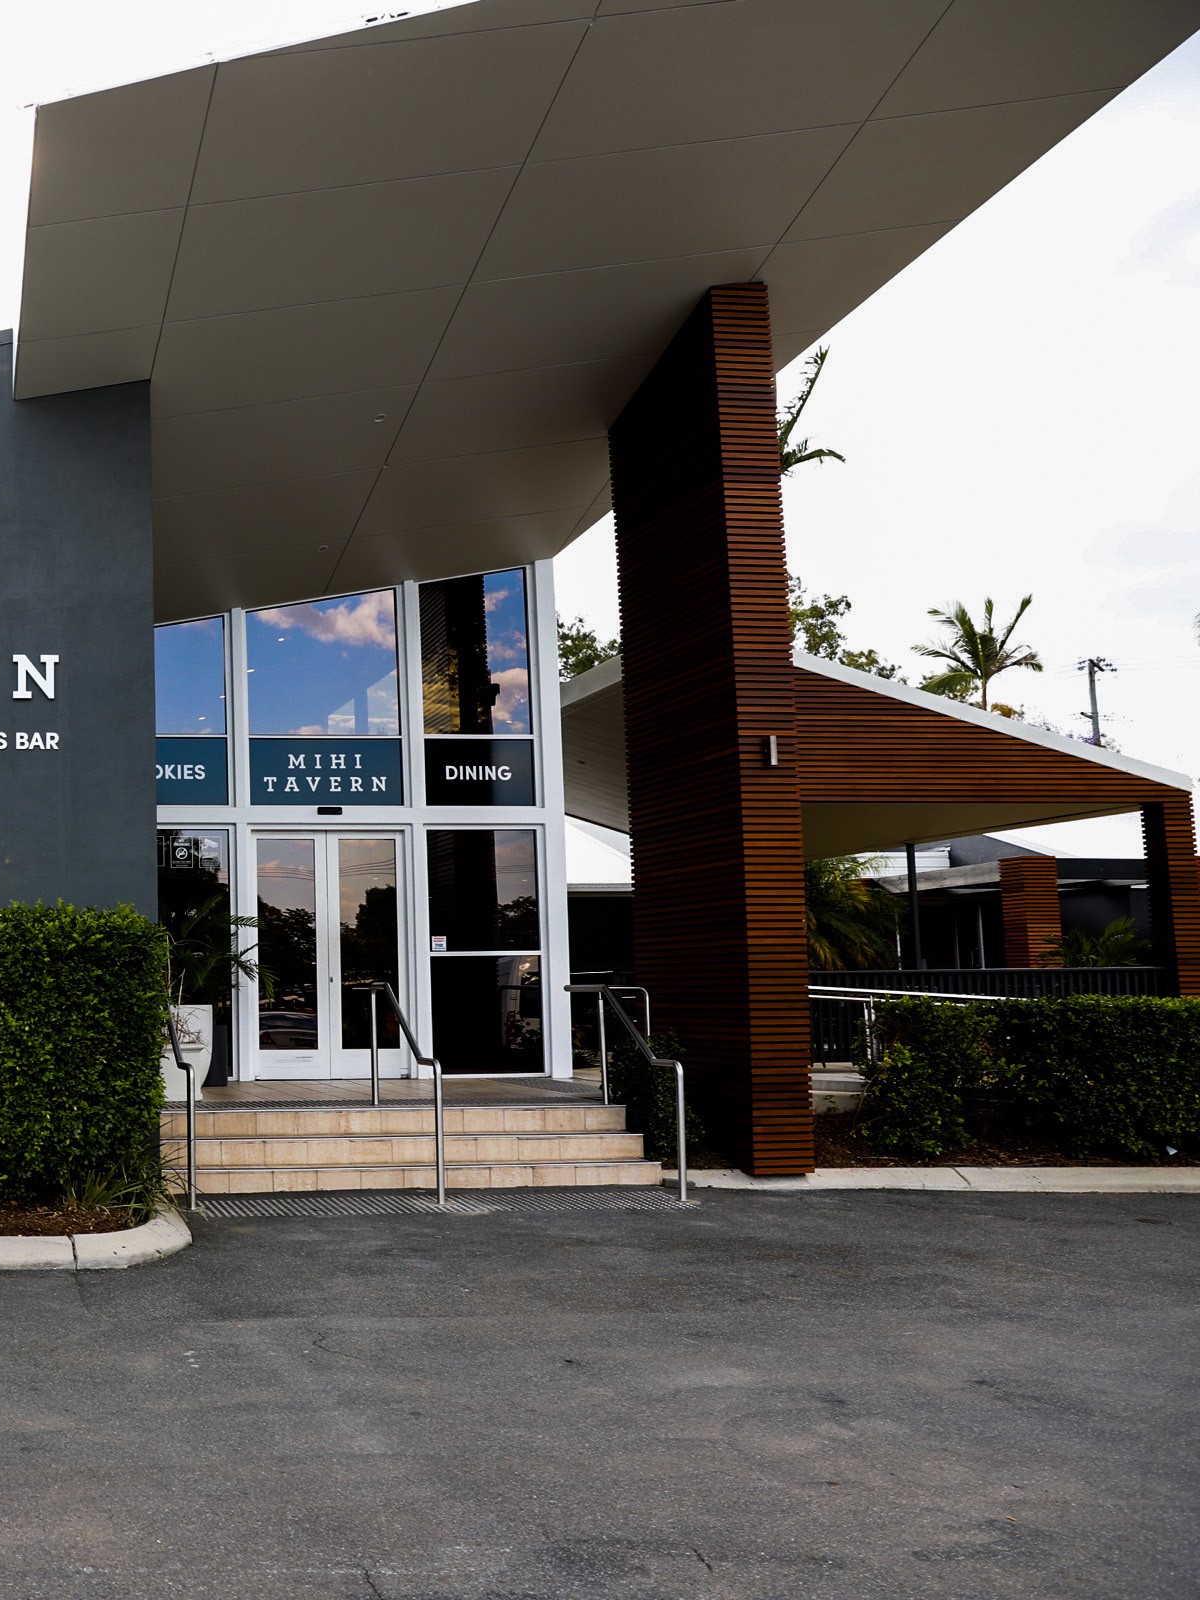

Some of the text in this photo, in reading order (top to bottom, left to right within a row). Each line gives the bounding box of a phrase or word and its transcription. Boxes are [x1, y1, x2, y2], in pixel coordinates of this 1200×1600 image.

[15, 731, 60, 750] BAR
[287, 753, 362, 769] MIHI
[445, 765, 512, 781] DINING
[263, 776, 387, 792] TAVERN
